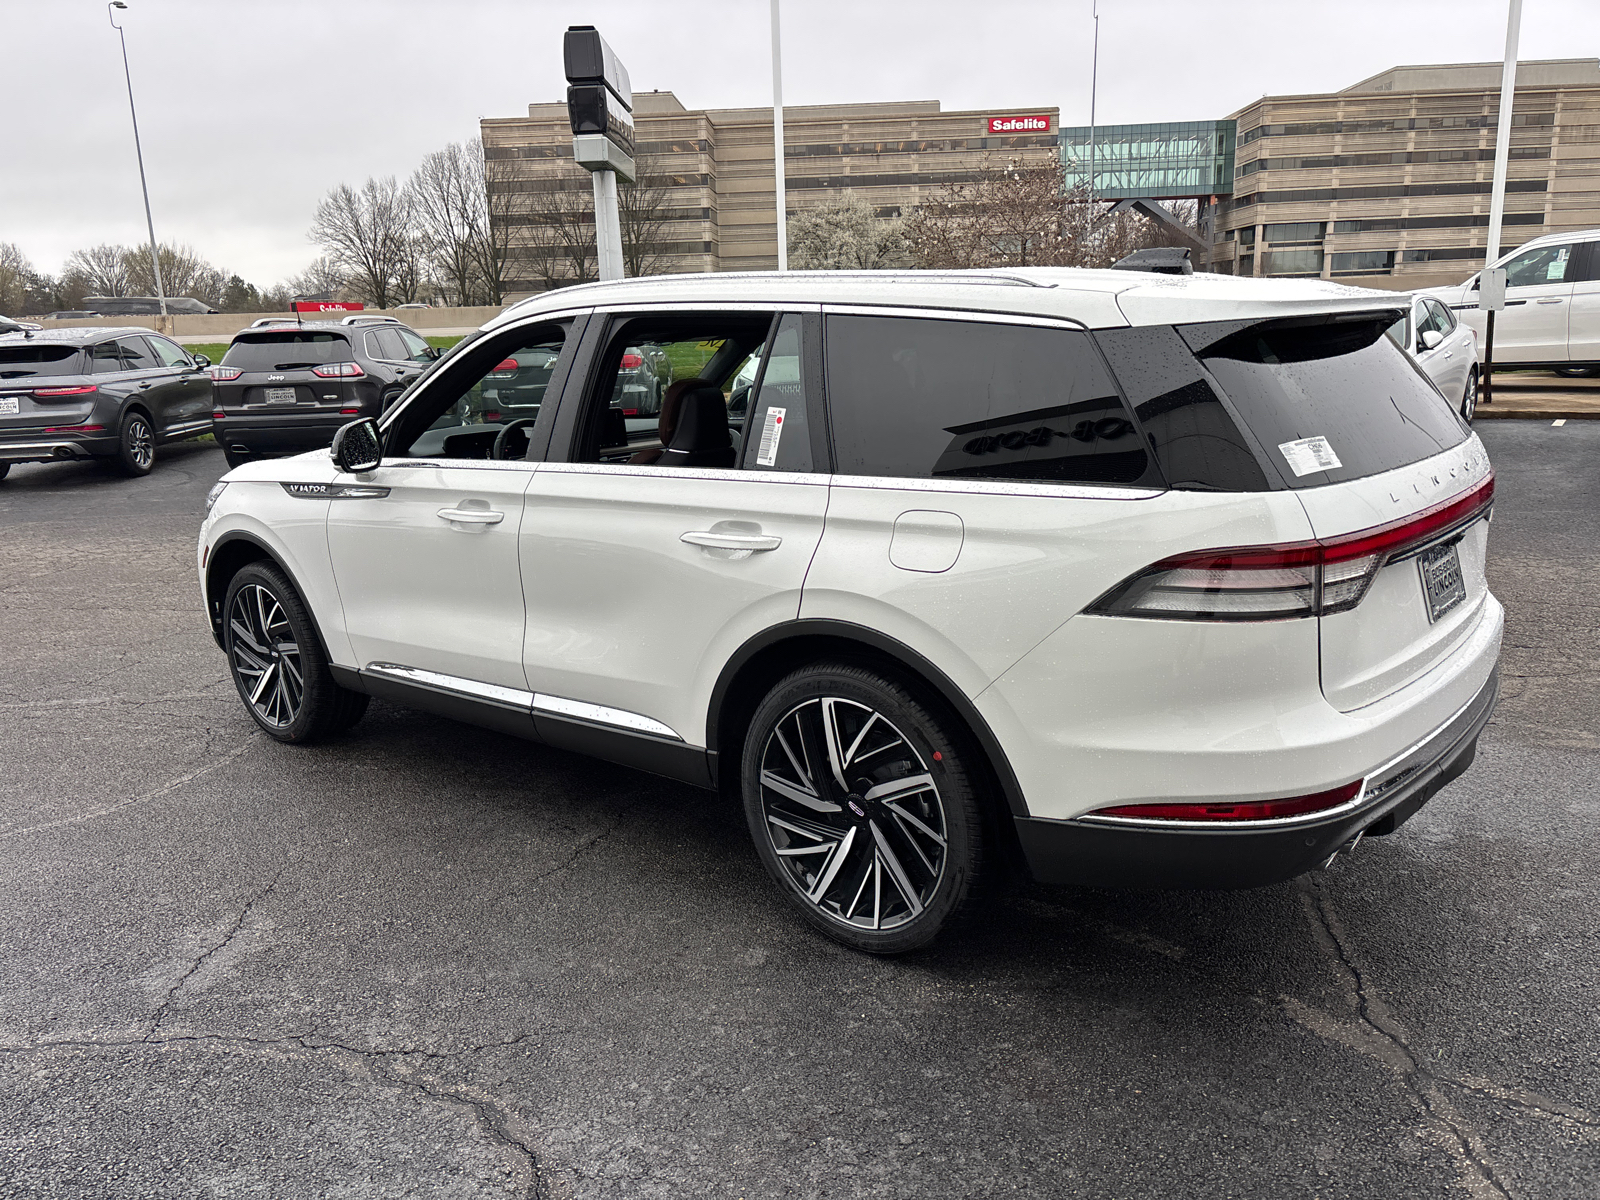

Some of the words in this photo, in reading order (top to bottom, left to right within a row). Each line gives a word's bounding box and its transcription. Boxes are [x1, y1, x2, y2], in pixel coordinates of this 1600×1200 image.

[992, 118, 1047, 131] Safelite
[268, 374, 285, 382] Jeep
[1432, 567, 1460, 597] LINCOLN
